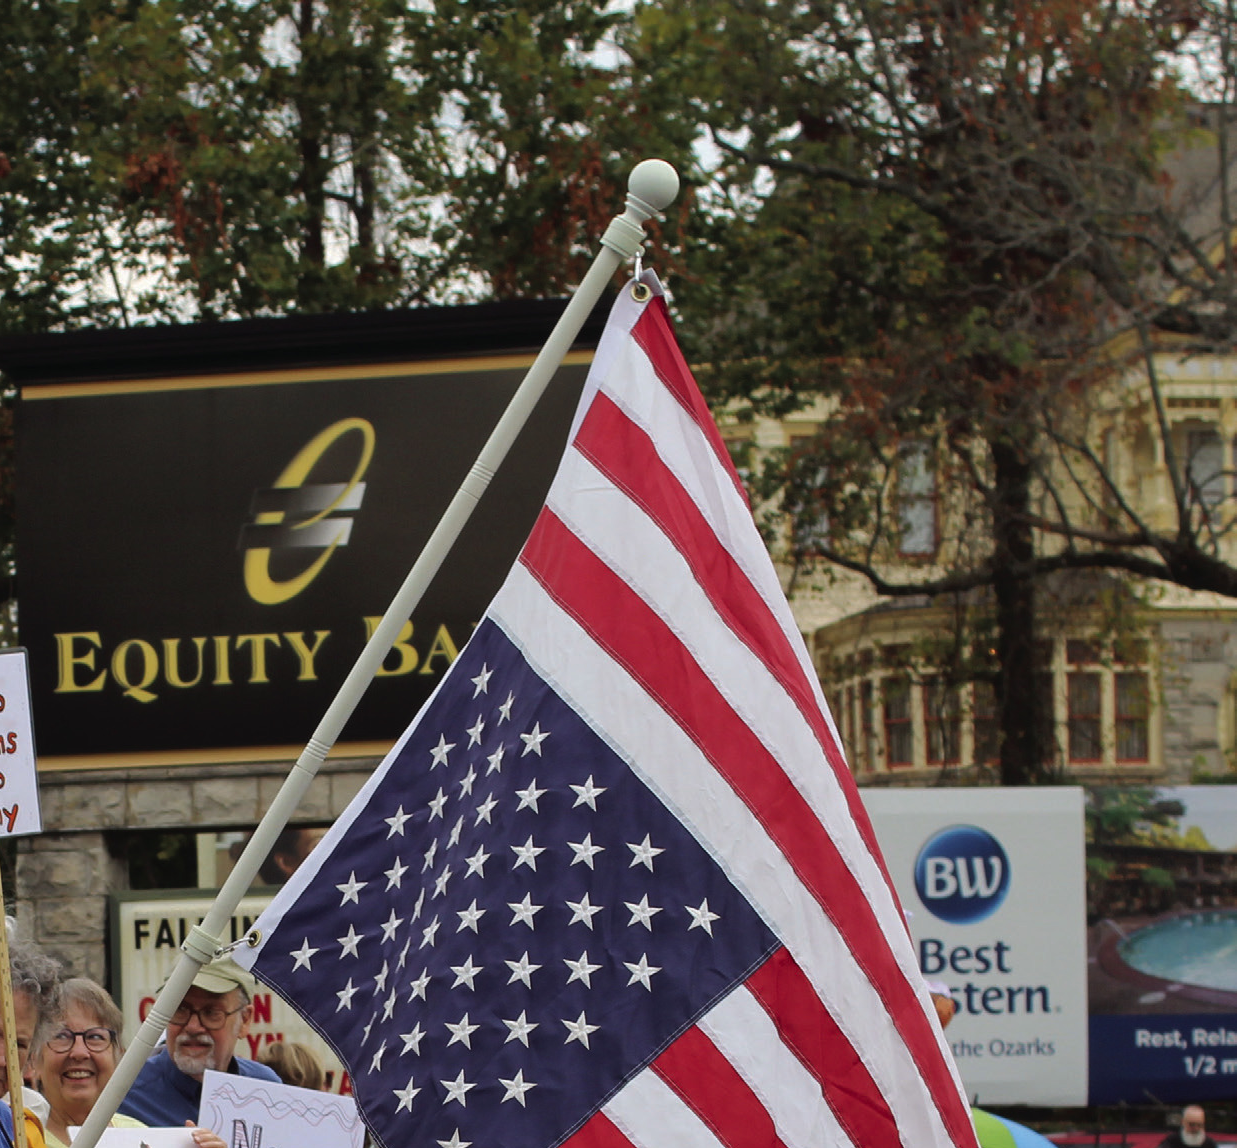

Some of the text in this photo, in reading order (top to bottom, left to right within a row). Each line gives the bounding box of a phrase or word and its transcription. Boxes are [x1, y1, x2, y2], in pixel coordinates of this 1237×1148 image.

[53, 615, 477, 703] EQUITY BA
[924, 856, 1003, 899] BW
[919, 939, 1012, 974] Best
[950, 983, 1052, 1016] stern
[989, 1037, 1056, 1058] Ozarks
[1135, 1028, 1188, 1050] Rest,
[1184, 1055, 1217, 1078] 1/2
